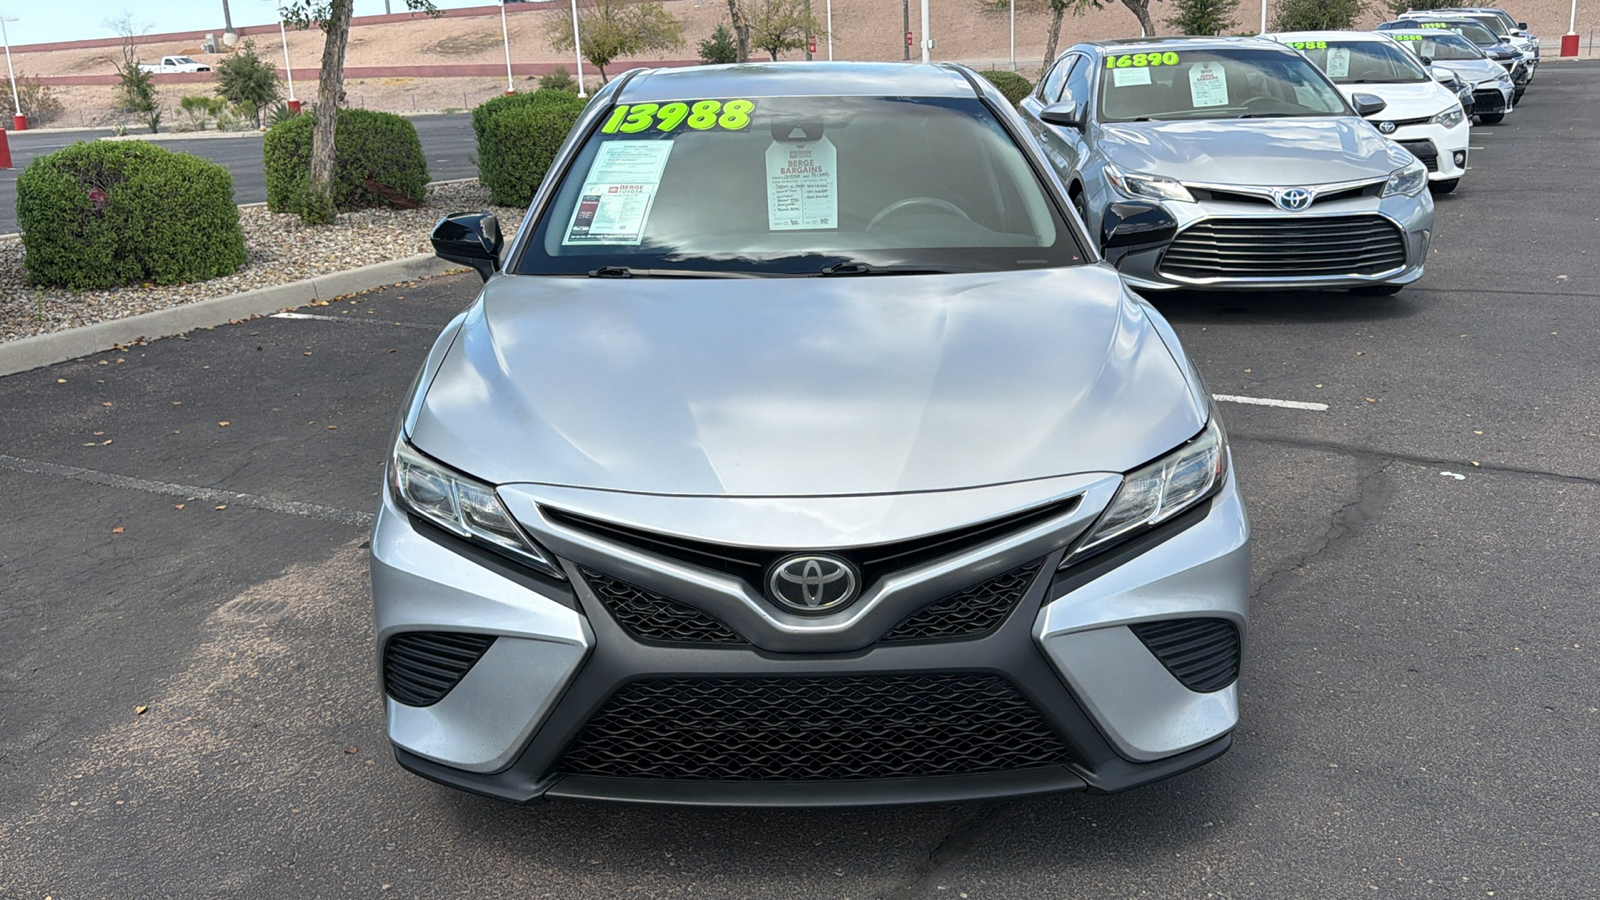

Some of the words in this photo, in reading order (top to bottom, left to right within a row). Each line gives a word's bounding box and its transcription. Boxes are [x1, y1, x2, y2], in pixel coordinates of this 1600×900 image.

[1106, 51, 1180, 69] 16890
[601, 99, 755, 134] 13988
[780, 166, 823, 174] BARGAINS
